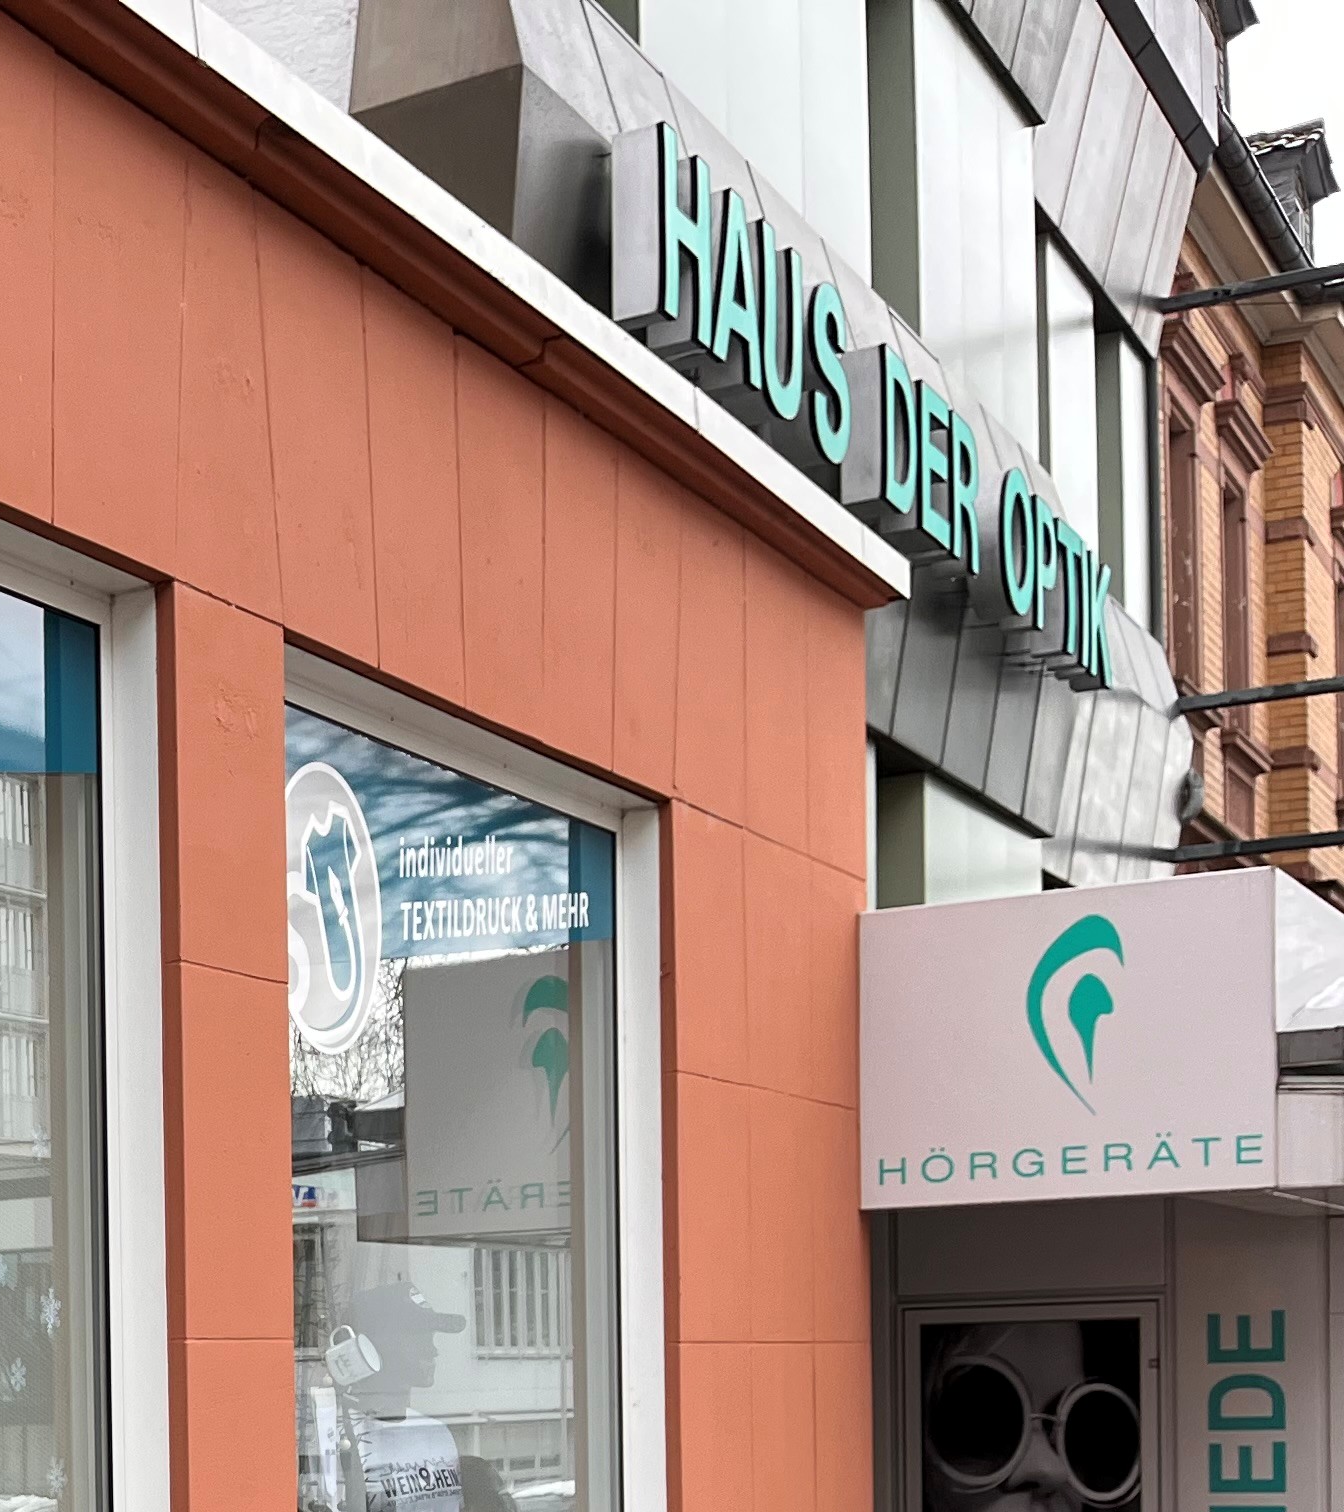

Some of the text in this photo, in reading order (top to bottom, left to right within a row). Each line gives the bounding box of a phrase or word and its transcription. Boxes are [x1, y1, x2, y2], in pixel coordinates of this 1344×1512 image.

[659, 121, 1114, 690] HAUS DER OPTIK
[399, 836, 513, 878] individueller
[400, 892, 590, 941] TEXTILDRUCK & MEHR
[878, 1131, 1265, 1187] HÖRGERÄTE
